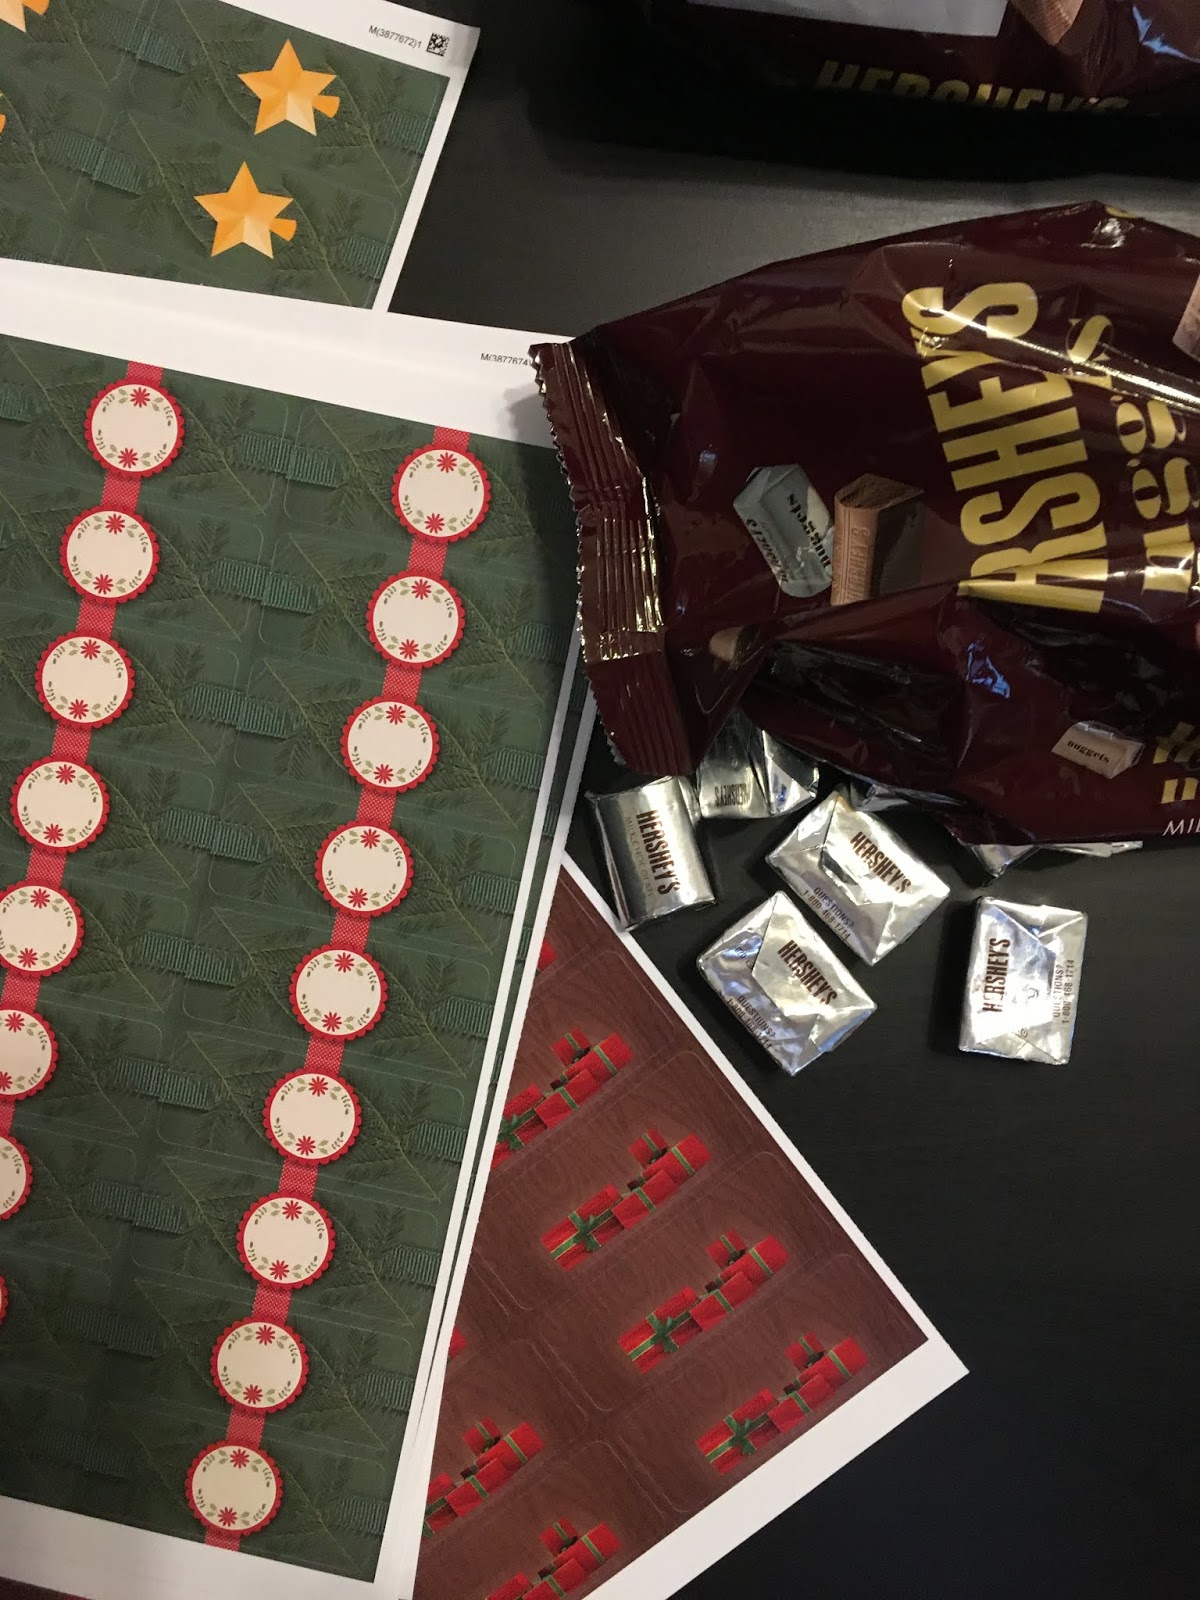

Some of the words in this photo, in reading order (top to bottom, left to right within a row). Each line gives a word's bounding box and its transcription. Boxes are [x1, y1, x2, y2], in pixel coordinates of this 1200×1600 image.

[368, 24, 422, 49] M(3877672)1
[1067, 739, 1110, 764] nuggets
[636, 809, 682, 896] HERSHEY'S
[850, 831, 912, 893] HERSHEY'S
[813, 886, 856, 927] QUESTIONS?
[777, 939, 838, 1006] HERSHEY'S
[737, 994, 777, 1037] QUESTIONS?
